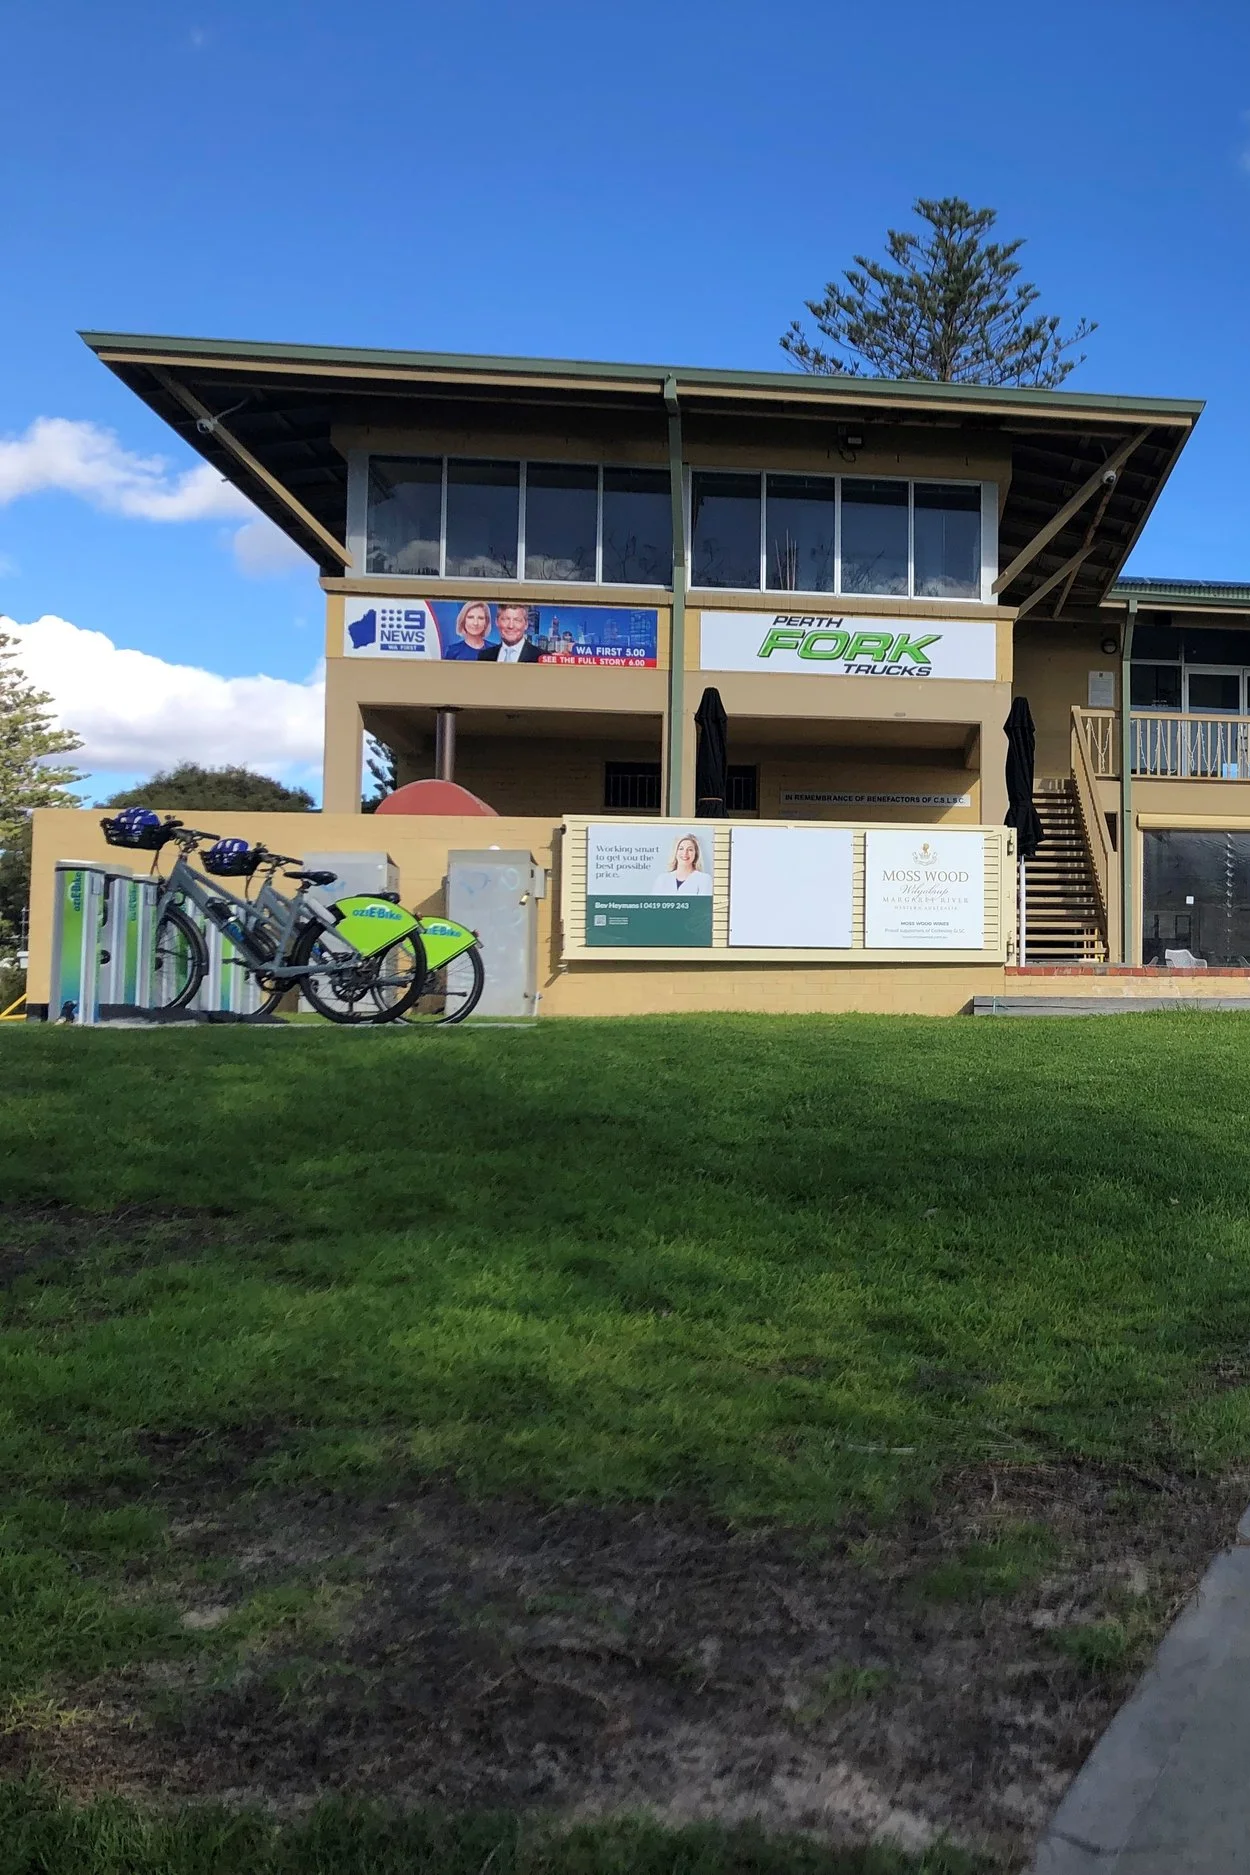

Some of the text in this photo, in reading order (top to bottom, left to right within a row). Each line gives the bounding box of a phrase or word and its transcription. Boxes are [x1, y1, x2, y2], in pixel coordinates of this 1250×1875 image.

[404, 610, 426, 630] 9
[772, 615, 844, 629] PERTH
[380, 630, 426, 643] NEWS
[576, 646, 646, 657] WA FIRST 5.00
[757, 628, 944, 664] FORK
[542, 655, 557, 663] SEE
[560, 656, 575, 664] THE
[578, 657, 597, 665] FULL
[600, 658, 626, 666] STORY
[842, 664, 933, 677] TRUCKS
[794, 794, 853, 802] REMEMBRANCE
[866, 795, 921, 803] BENEFACTORS
[596, 845, 633, 854] Working
[606, 854, 620, 862] get
[616, 863, 652, 871] possible
[882, 870, 969, 882] MOSS WOOD
